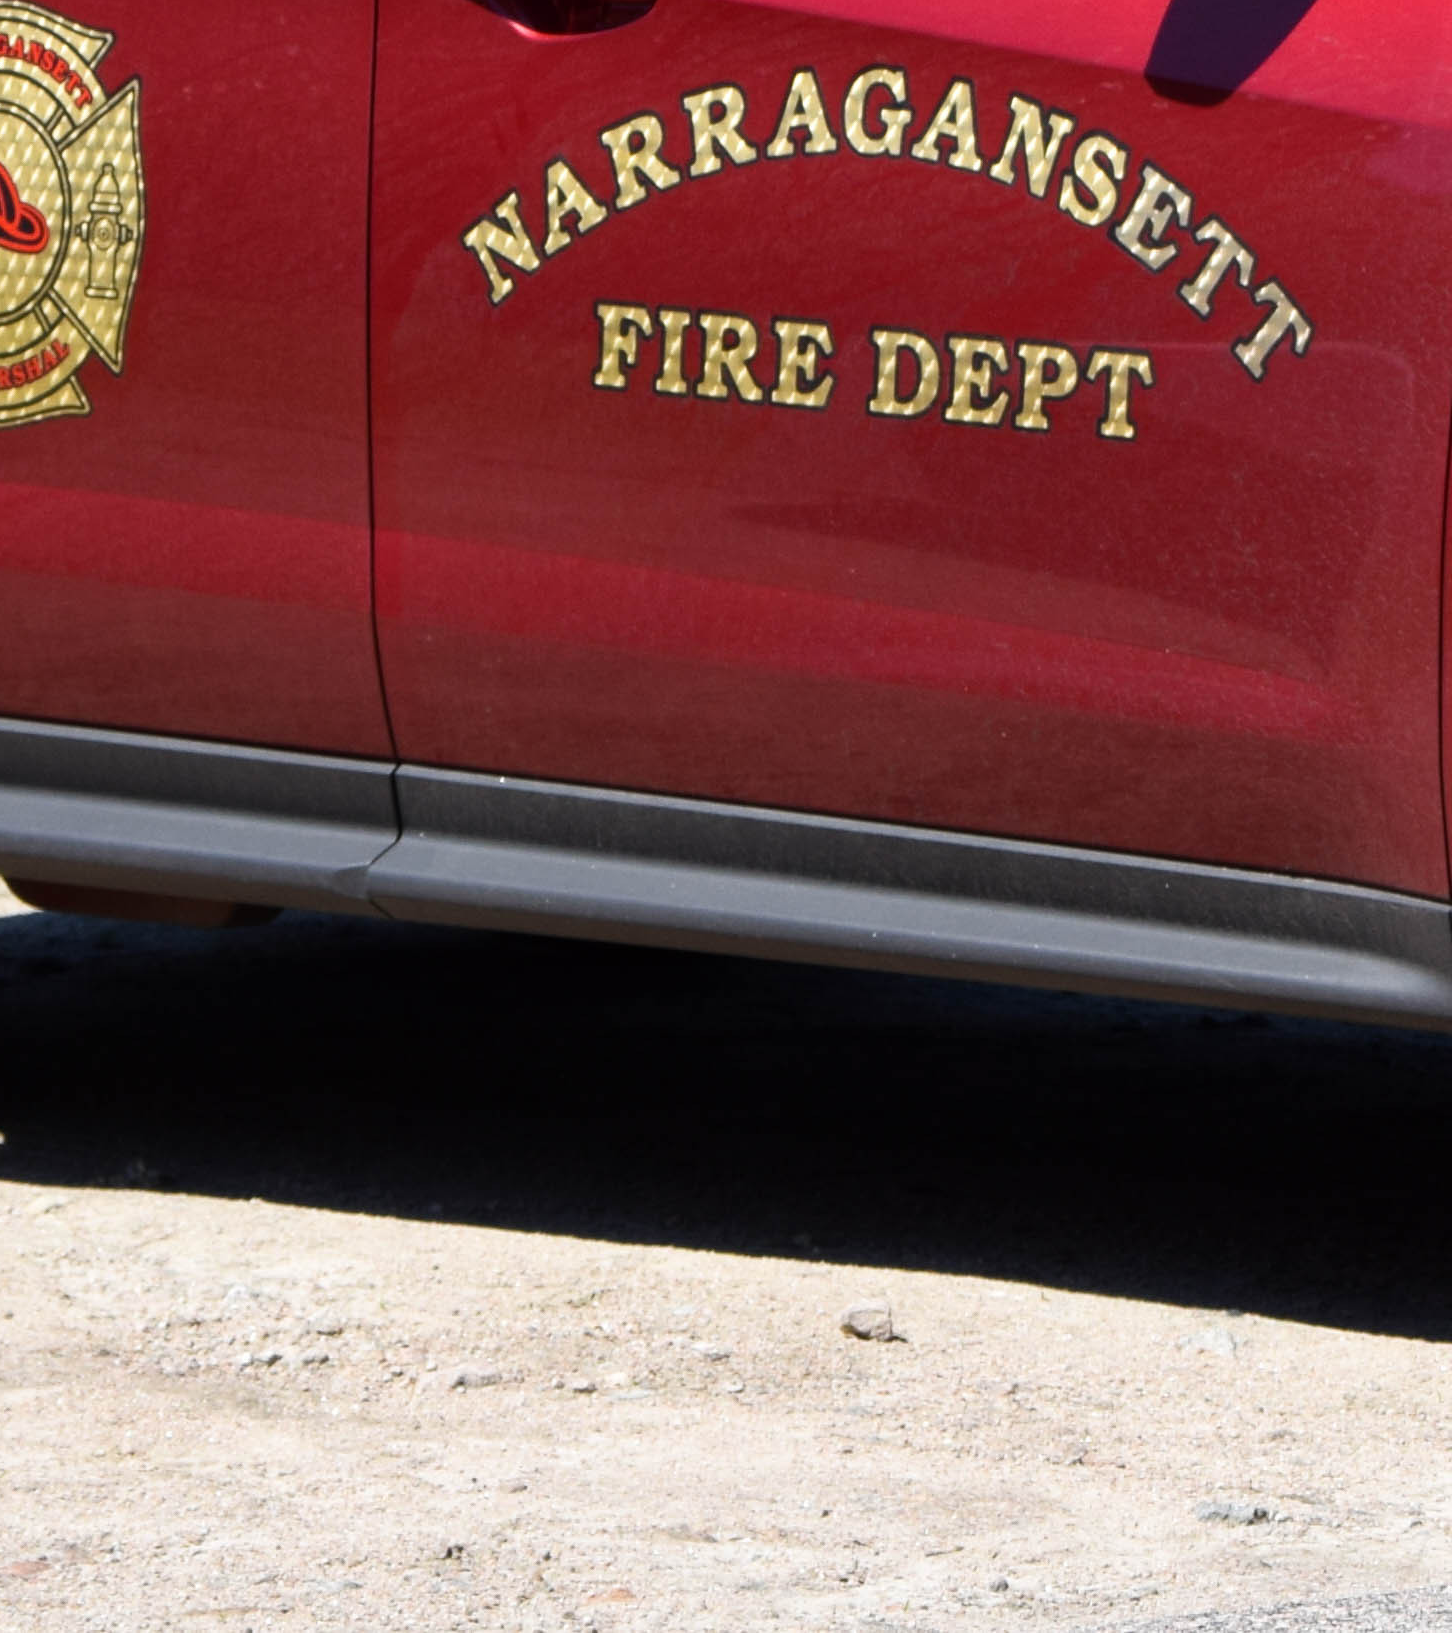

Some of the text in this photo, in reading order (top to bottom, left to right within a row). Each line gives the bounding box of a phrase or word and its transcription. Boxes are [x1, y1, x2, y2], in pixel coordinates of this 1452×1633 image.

[460, 63, 1316, 381] NARRAGANSETT
[592, 303, 1156, 441] FIRE DEPT
